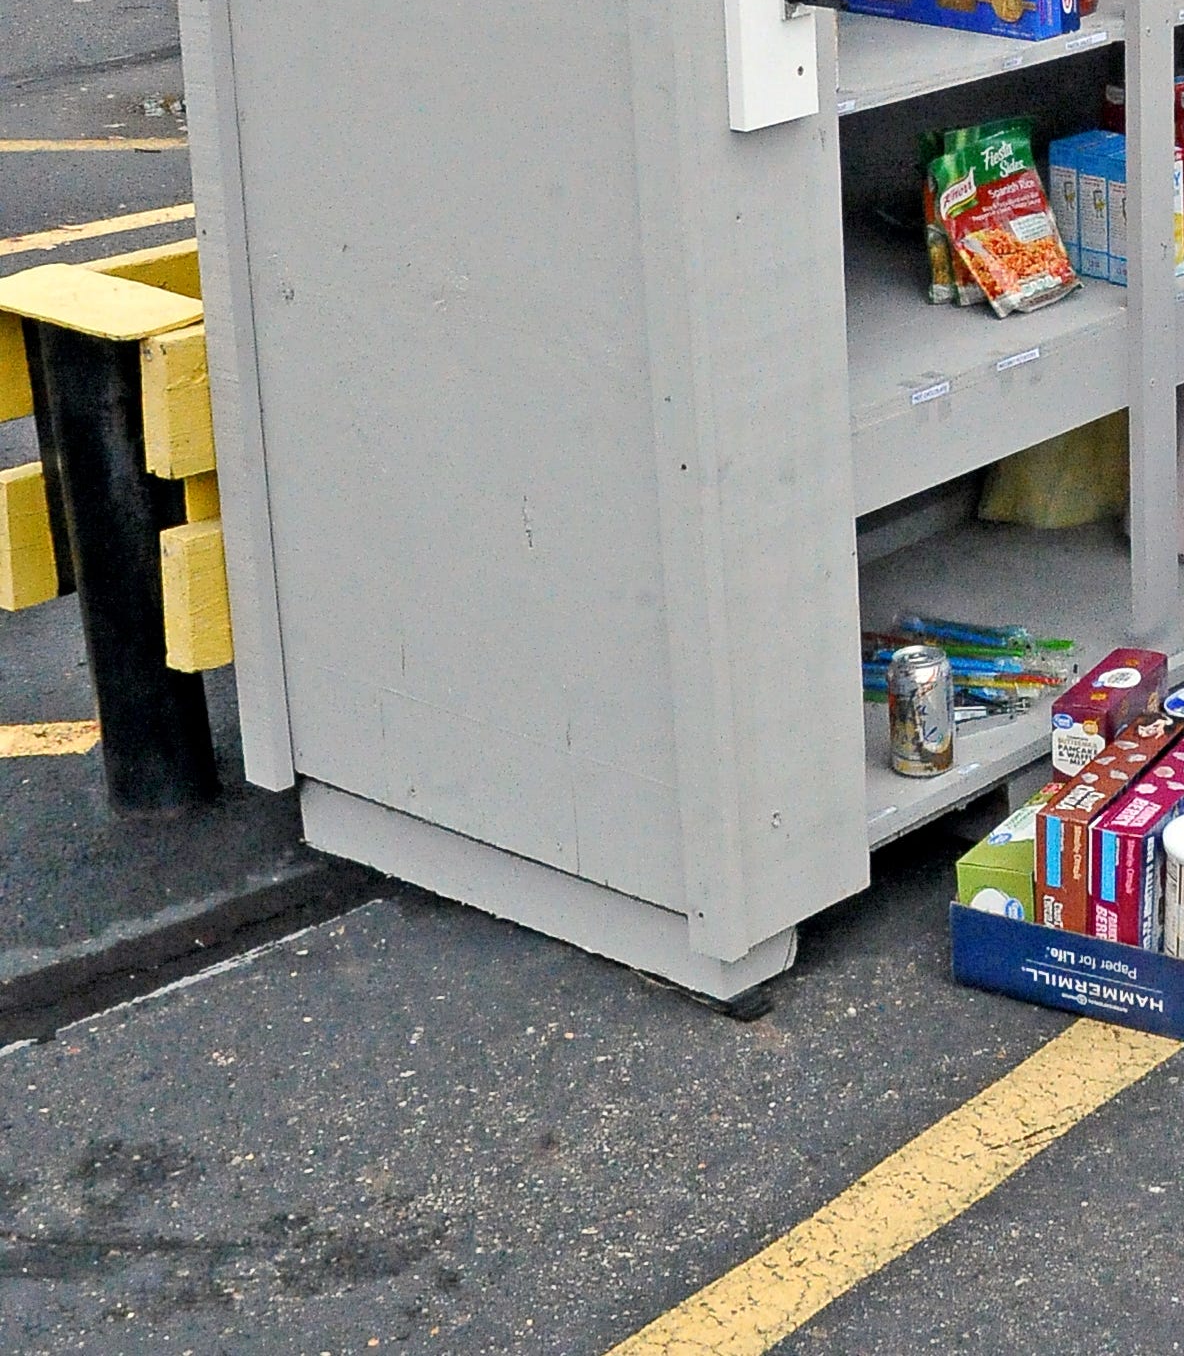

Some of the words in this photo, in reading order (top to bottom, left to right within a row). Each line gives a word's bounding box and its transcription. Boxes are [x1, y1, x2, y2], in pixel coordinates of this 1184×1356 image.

[980, 141, 1013, 171] Fiesta
[1000, 158, 1026, 177] Sides
[943, 179, 972, 208] Knorr
[988, 181, 1019, 197] Spanish
[1018, 178, 1036, 191] Rice
[1057, 744, 1098, 755] PANCAKE
[1078, 954, 1097, 970] for
[1100, 959, 1137, 980] Paper
[1024, 967, 1164, 1013] HAMMERMILL
